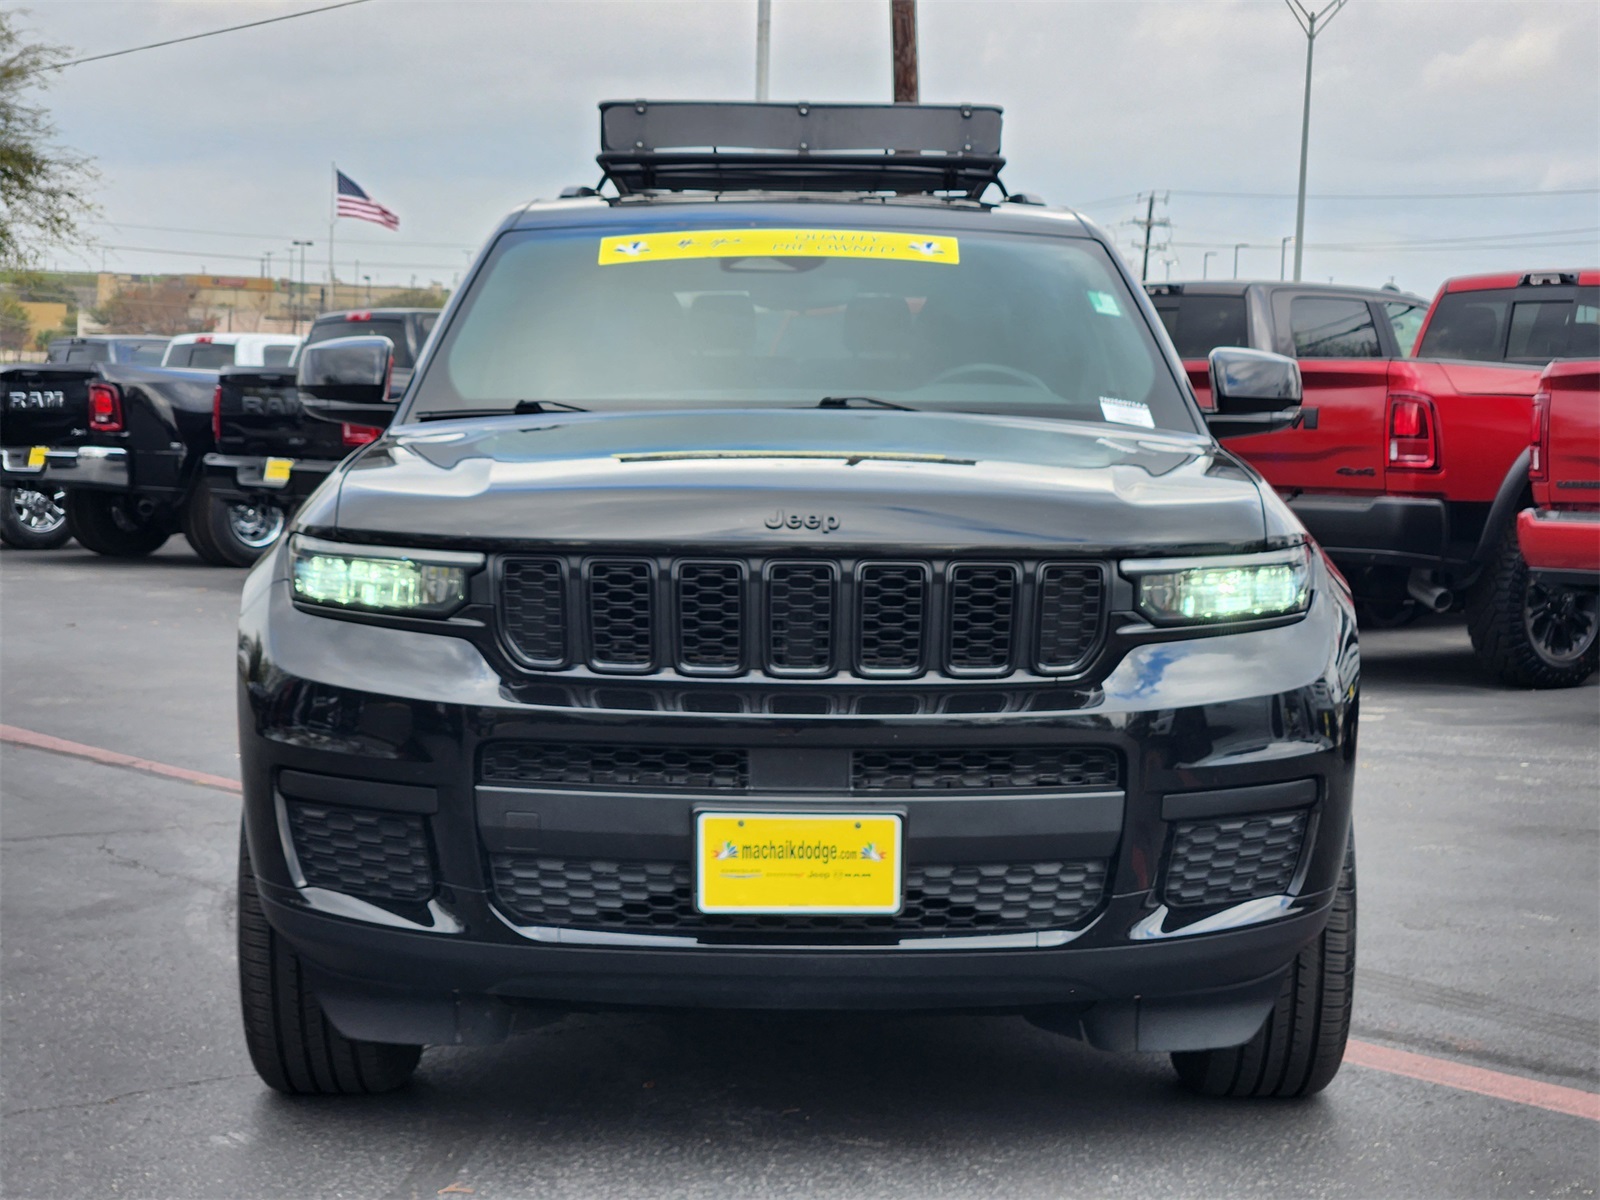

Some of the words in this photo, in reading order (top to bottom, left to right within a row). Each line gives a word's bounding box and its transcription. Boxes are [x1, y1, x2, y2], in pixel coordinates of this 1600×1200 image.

[9, 390, 64, 409] RAM
[764, 509, 841, 534] Jeep
[741, 840, 858, 864] machaikdodge.com
